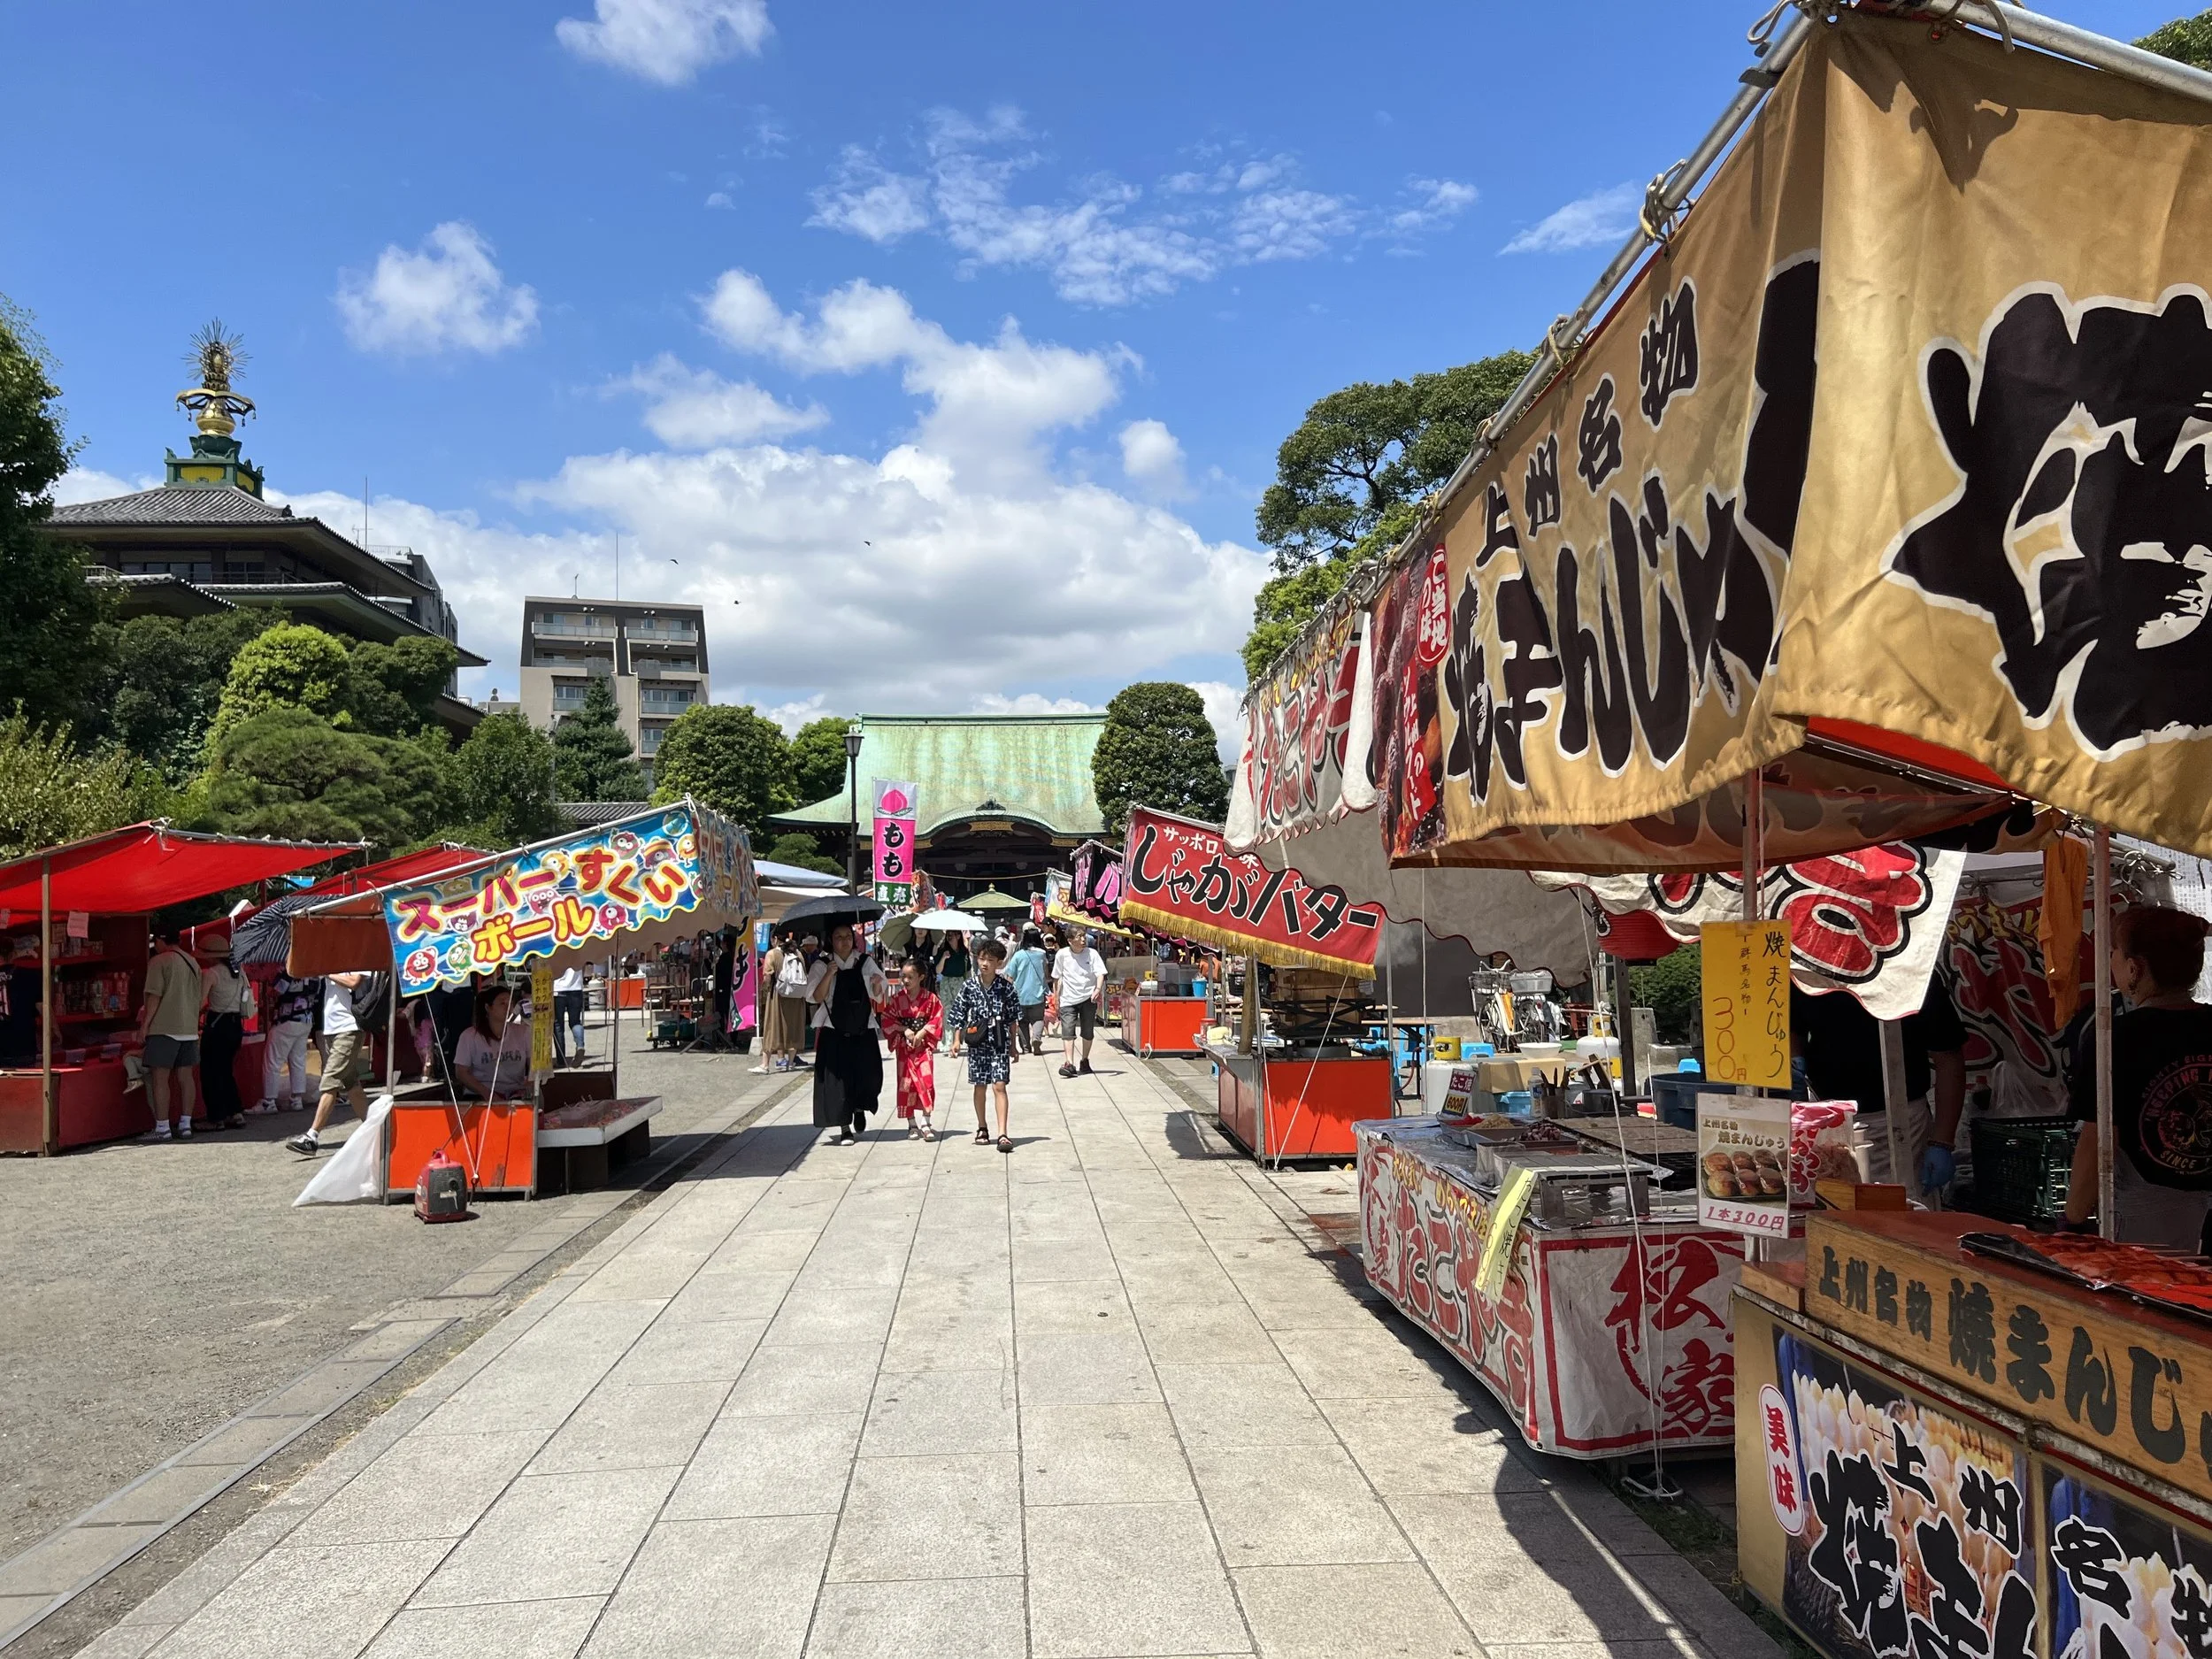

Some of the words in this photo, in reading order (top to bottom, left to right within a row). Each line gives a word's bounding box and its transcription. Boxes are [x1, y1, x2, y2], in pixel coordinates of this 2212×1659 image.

[1477, 281, 1694, 566] 上州名物
[881, 821, 904, 877] もも
[1163, 826, 1259, 870] サッポロ味
[396, 868, 557, 940] スーパー
[574, 846, 686, 906] すくい
[877, 885, 906, 902] 直売
[1130, 825, 1379, 942] じゃがバター
[472, 898, 595, 963] ボール
[1762, 931, 1786, 1079] 焼まんじゅう
[1712, 996, 1747, 1081] 300円
[1450, 1075, 1473, 1091] たこ焼
[1702, 1118, 1739, 1132] 上州名物
[1717, 1131, 1786, 1149] 焼まんじゅう
[2159, 1149, 2200, 1170] SINCE
[1705, 1206, 1786, 1231] 1本300円
[1819, 1245, 1932, 1343] 上州名物
[1764, 1403, 1799, 1514] 美味
